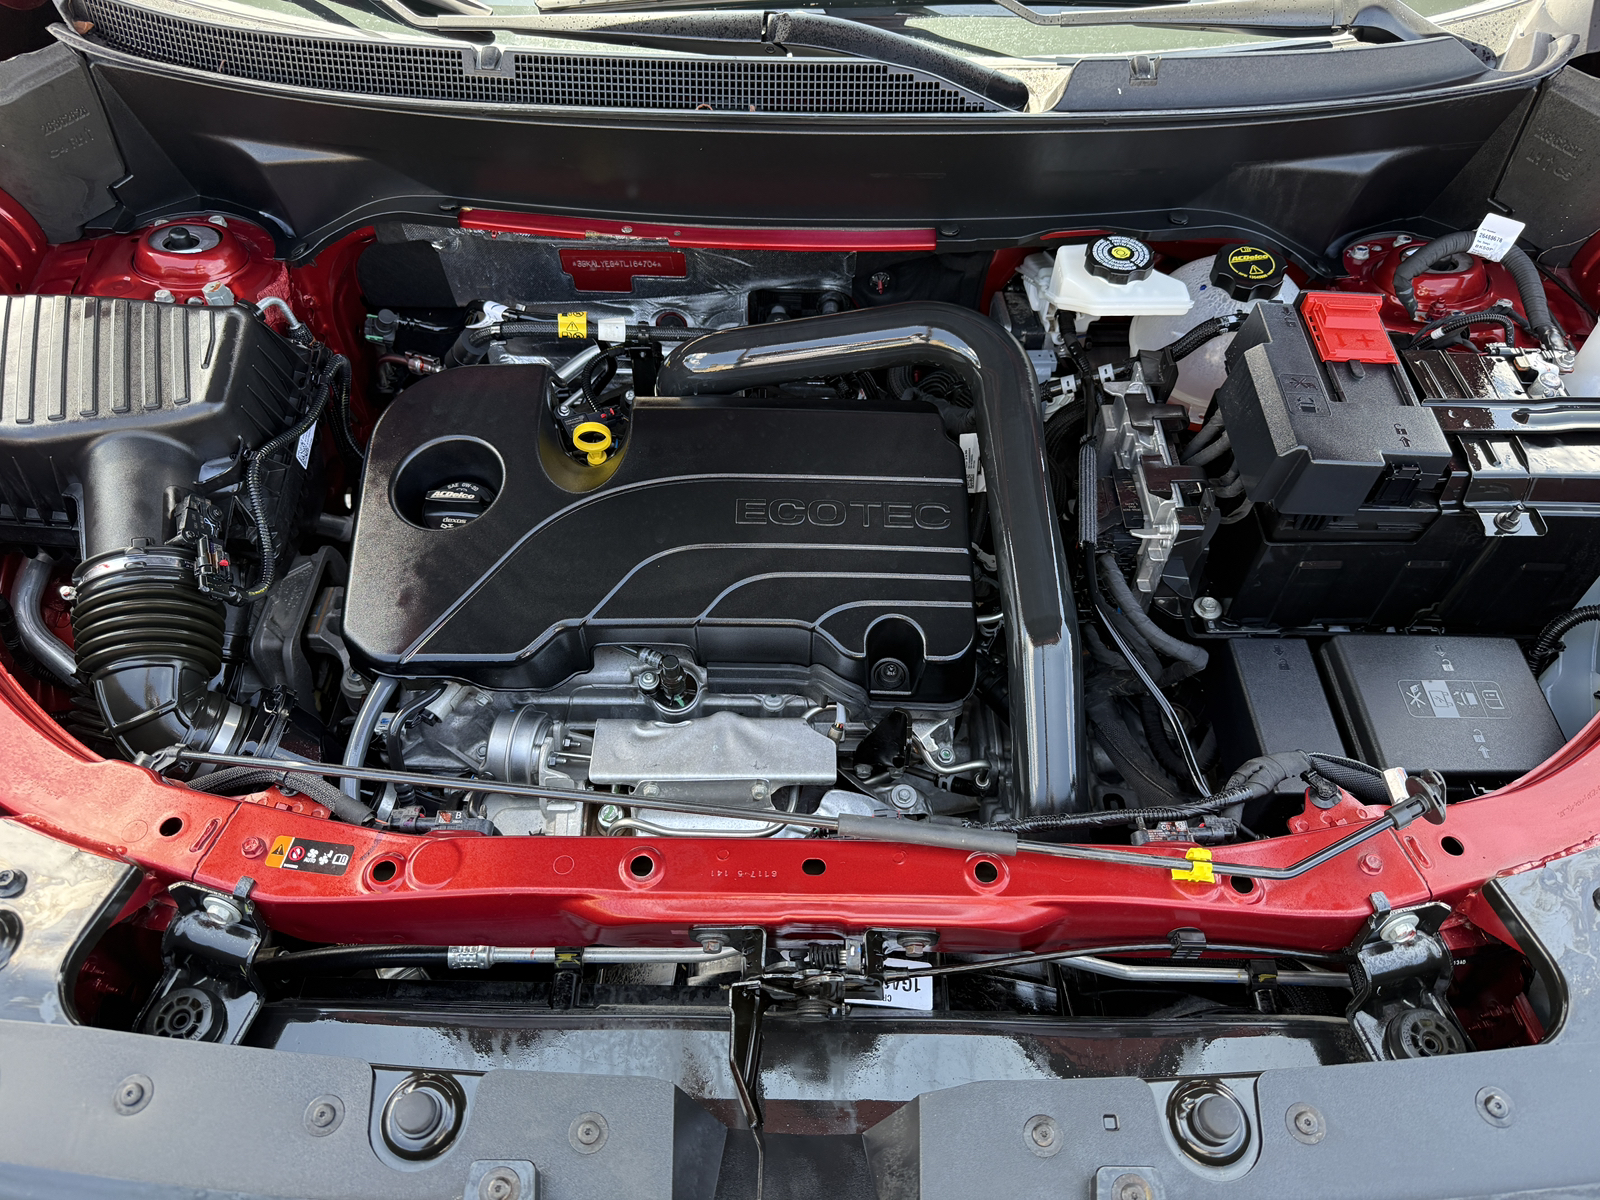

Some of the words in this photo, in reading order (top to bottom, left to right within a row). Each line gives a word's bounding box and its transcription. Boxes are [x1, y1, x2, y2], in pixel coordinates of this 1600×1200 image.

[430, 491, 475, 499] ACDelco
[735, 498, 951, 529] ECOTEC
[302, 856, 317, 864] AUTO
